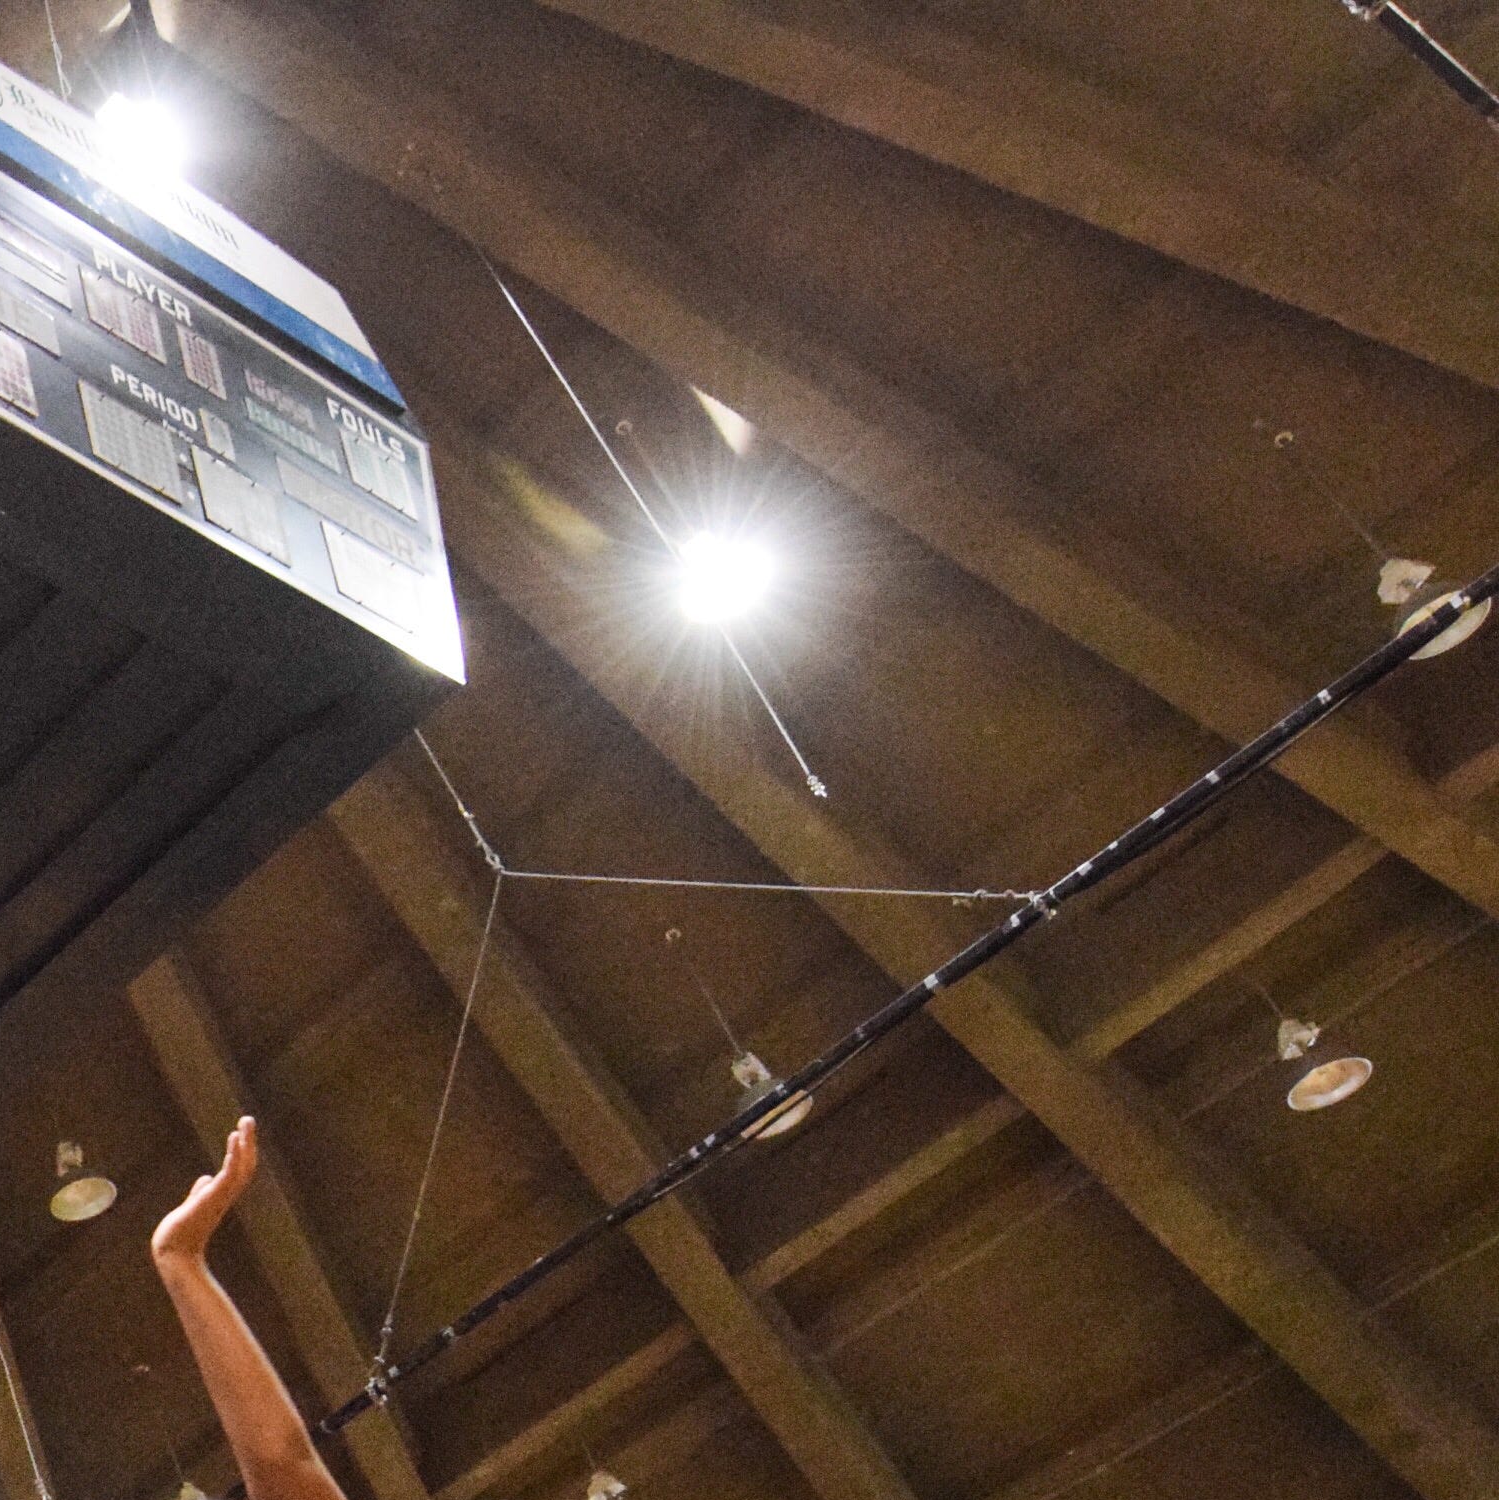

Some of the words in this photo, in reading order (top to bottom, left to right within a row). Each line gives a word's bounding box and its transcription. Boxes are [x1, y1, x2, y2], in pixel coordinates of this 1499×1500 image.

[93, 247, 192, 327] PLAYER
[111, 364, 198, 432] PERIOD
[326, 398, 406, 463] FOULS
